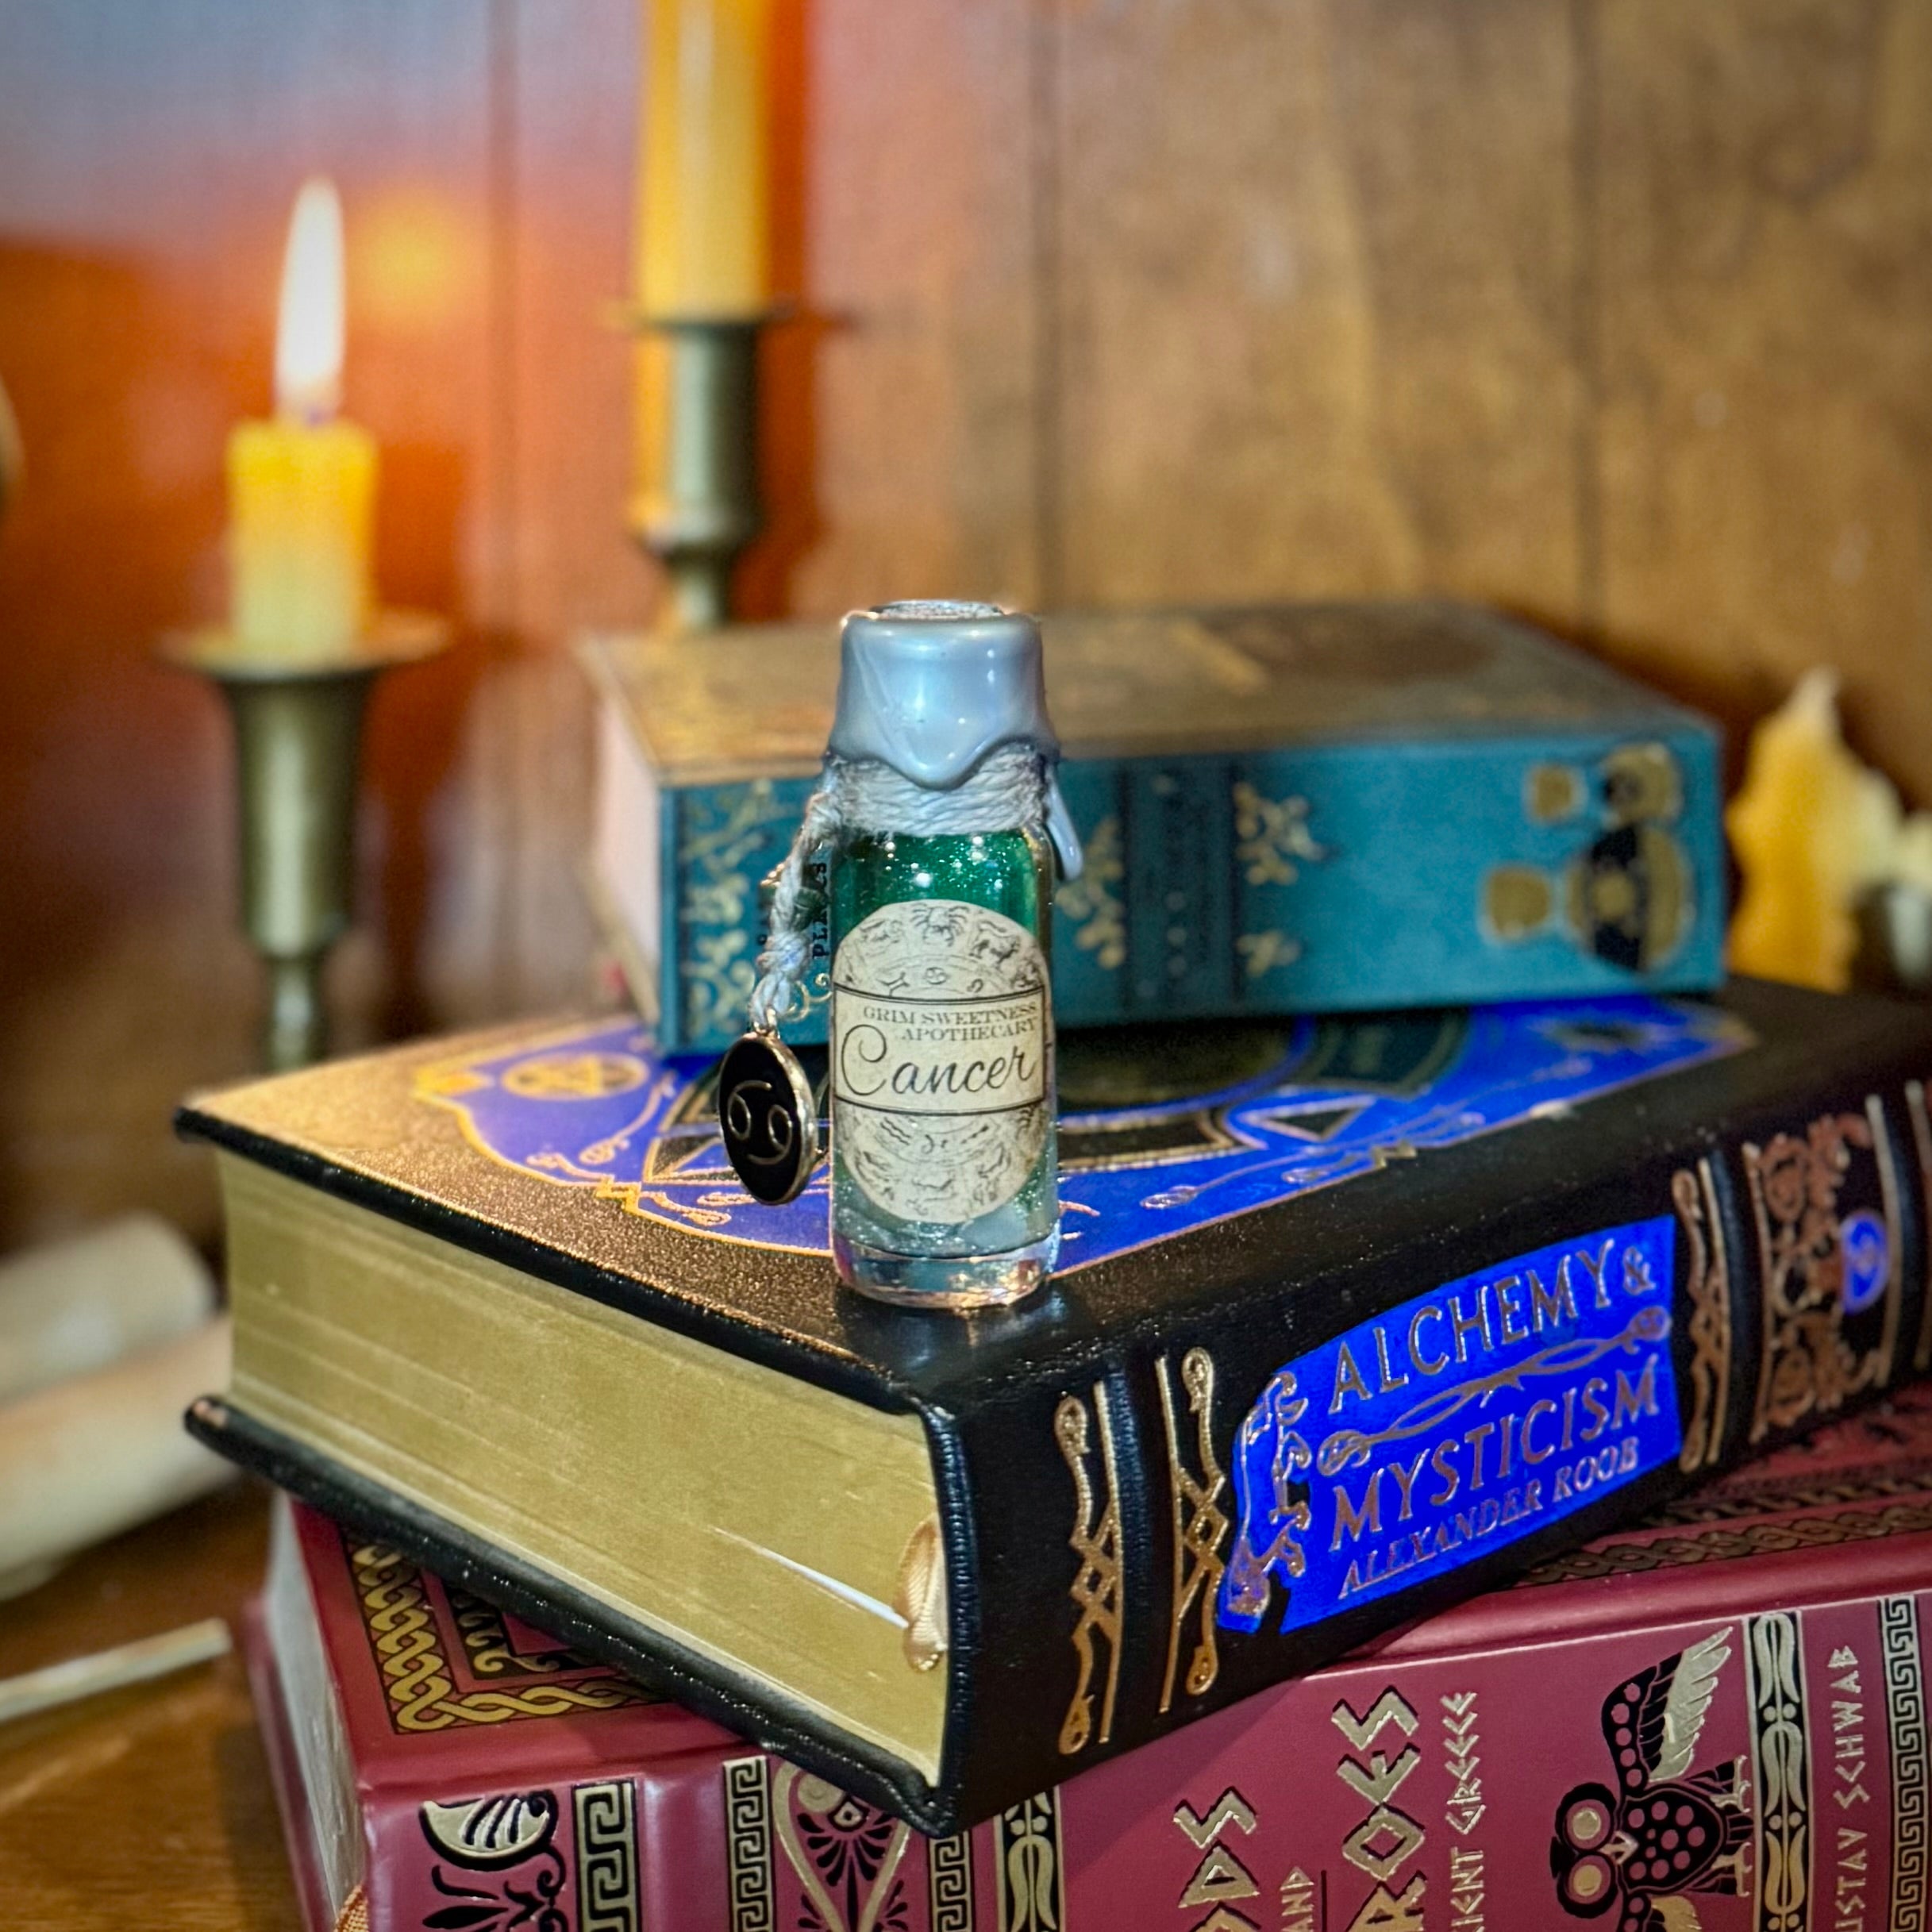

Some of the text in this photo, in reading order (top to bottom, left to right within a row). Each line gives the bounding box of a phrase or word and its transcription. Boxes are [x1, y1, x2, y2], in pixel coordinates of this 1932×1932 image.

[841, 1024, 1037, 1096] Cancer
[863, 1002, 1037, 1026] GRIM SWEETNESS
[900, 1016, 1038, 1042] APOTHECARY
[1327, 1238, 1657, 1415] ALCHEMY &
[1328, 1353, 1661, 1553] MYSTICISM
[1337, 1436, 1640, 1600] ALEXANDER ROOB
[1828, 1645, 1871, 1810] SCHWAB
[1439, 1691, 1486, 1932] IENT GREECE
